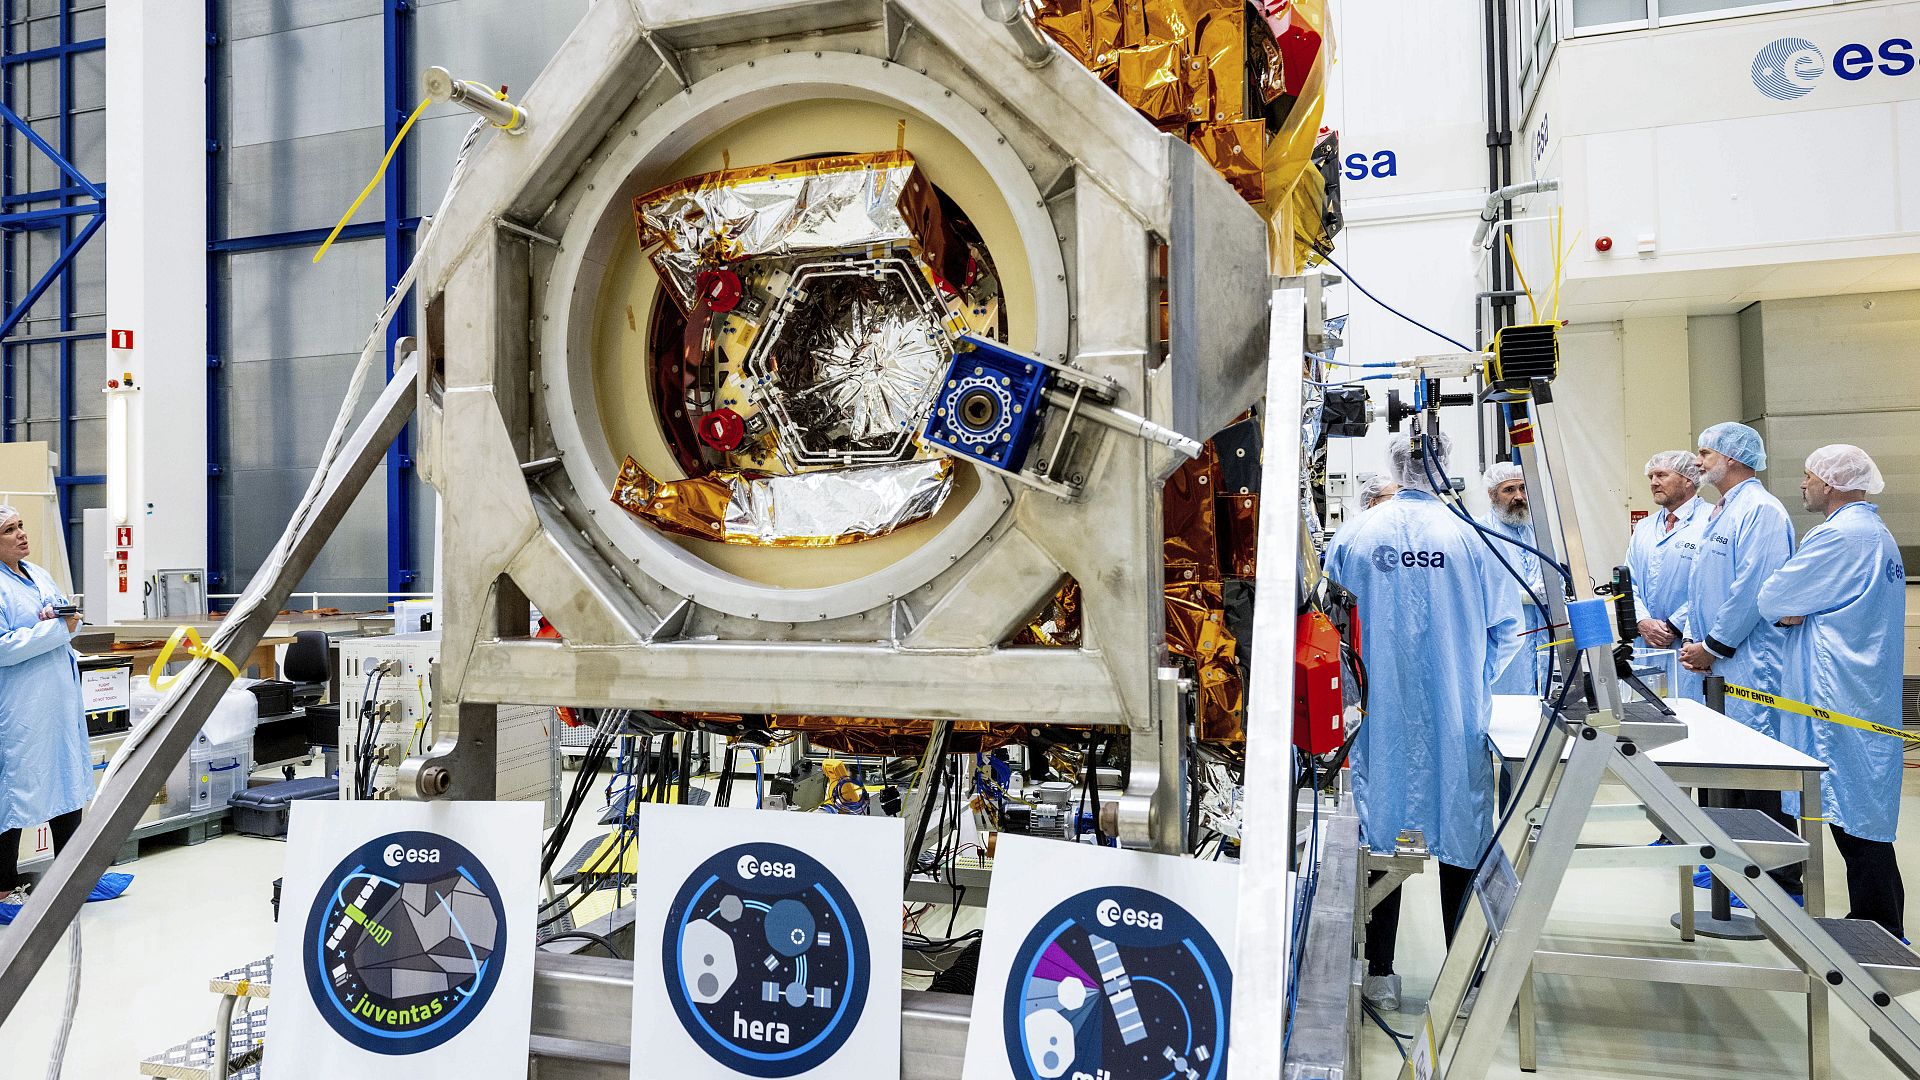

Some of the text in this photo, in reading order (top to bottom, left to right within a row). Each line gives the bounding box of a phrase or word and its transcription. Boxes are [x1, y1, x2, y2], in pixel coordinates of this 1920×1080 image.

[1832, 38, 1920, 81] es
[1536, 112, 1549, 161] esa
[1339, 149, 1398, 180] sa
[1401, 550, 1445, 568] esa
[1723, 685, 1775, 705] DO NOT ENTER
[406, 848, 440, 863] esa
[760, 861, 796, 879] esa
[1122, 908, 1164, 931] esa
[351, 993, 443, 1025] juventas
[733, 1010, 790, 1044] hera
